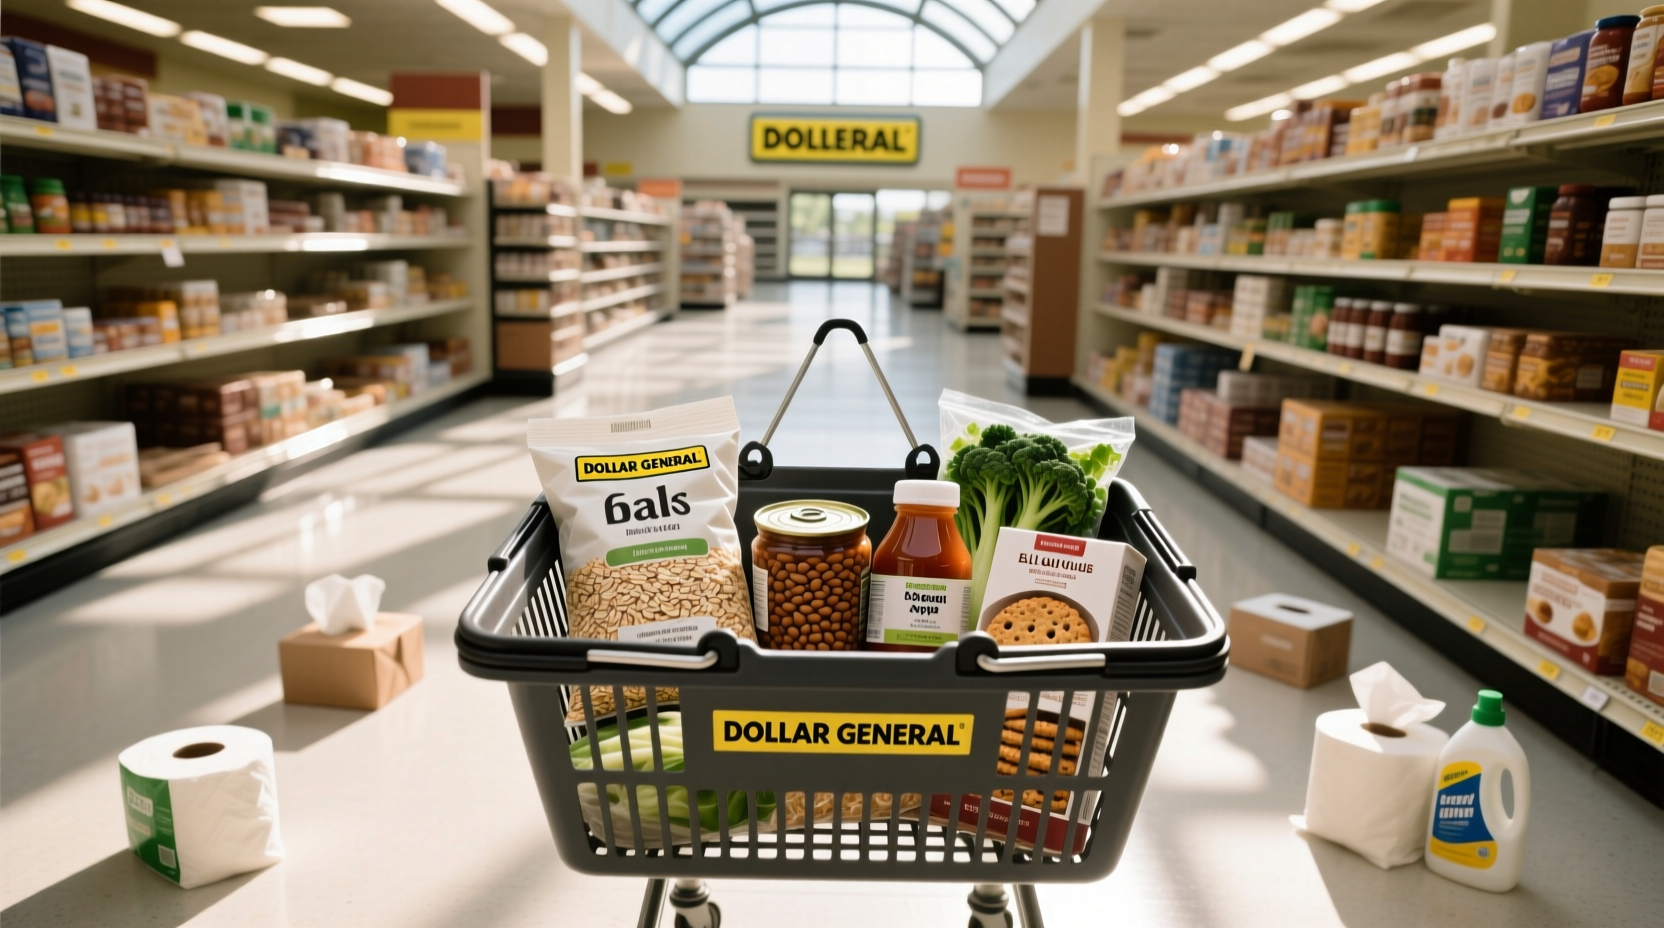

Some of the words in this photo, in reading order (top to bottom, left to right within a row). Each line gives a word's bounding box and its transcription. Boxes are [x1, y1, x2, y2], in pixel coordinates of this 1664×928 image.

[764, 127, 906, 152] DOLLERAL
[583, 460, 638, 475] DOLLAR
[723, 720, 830, 744] DOLLAR
[836, 722, 960, 746] GENERAL
